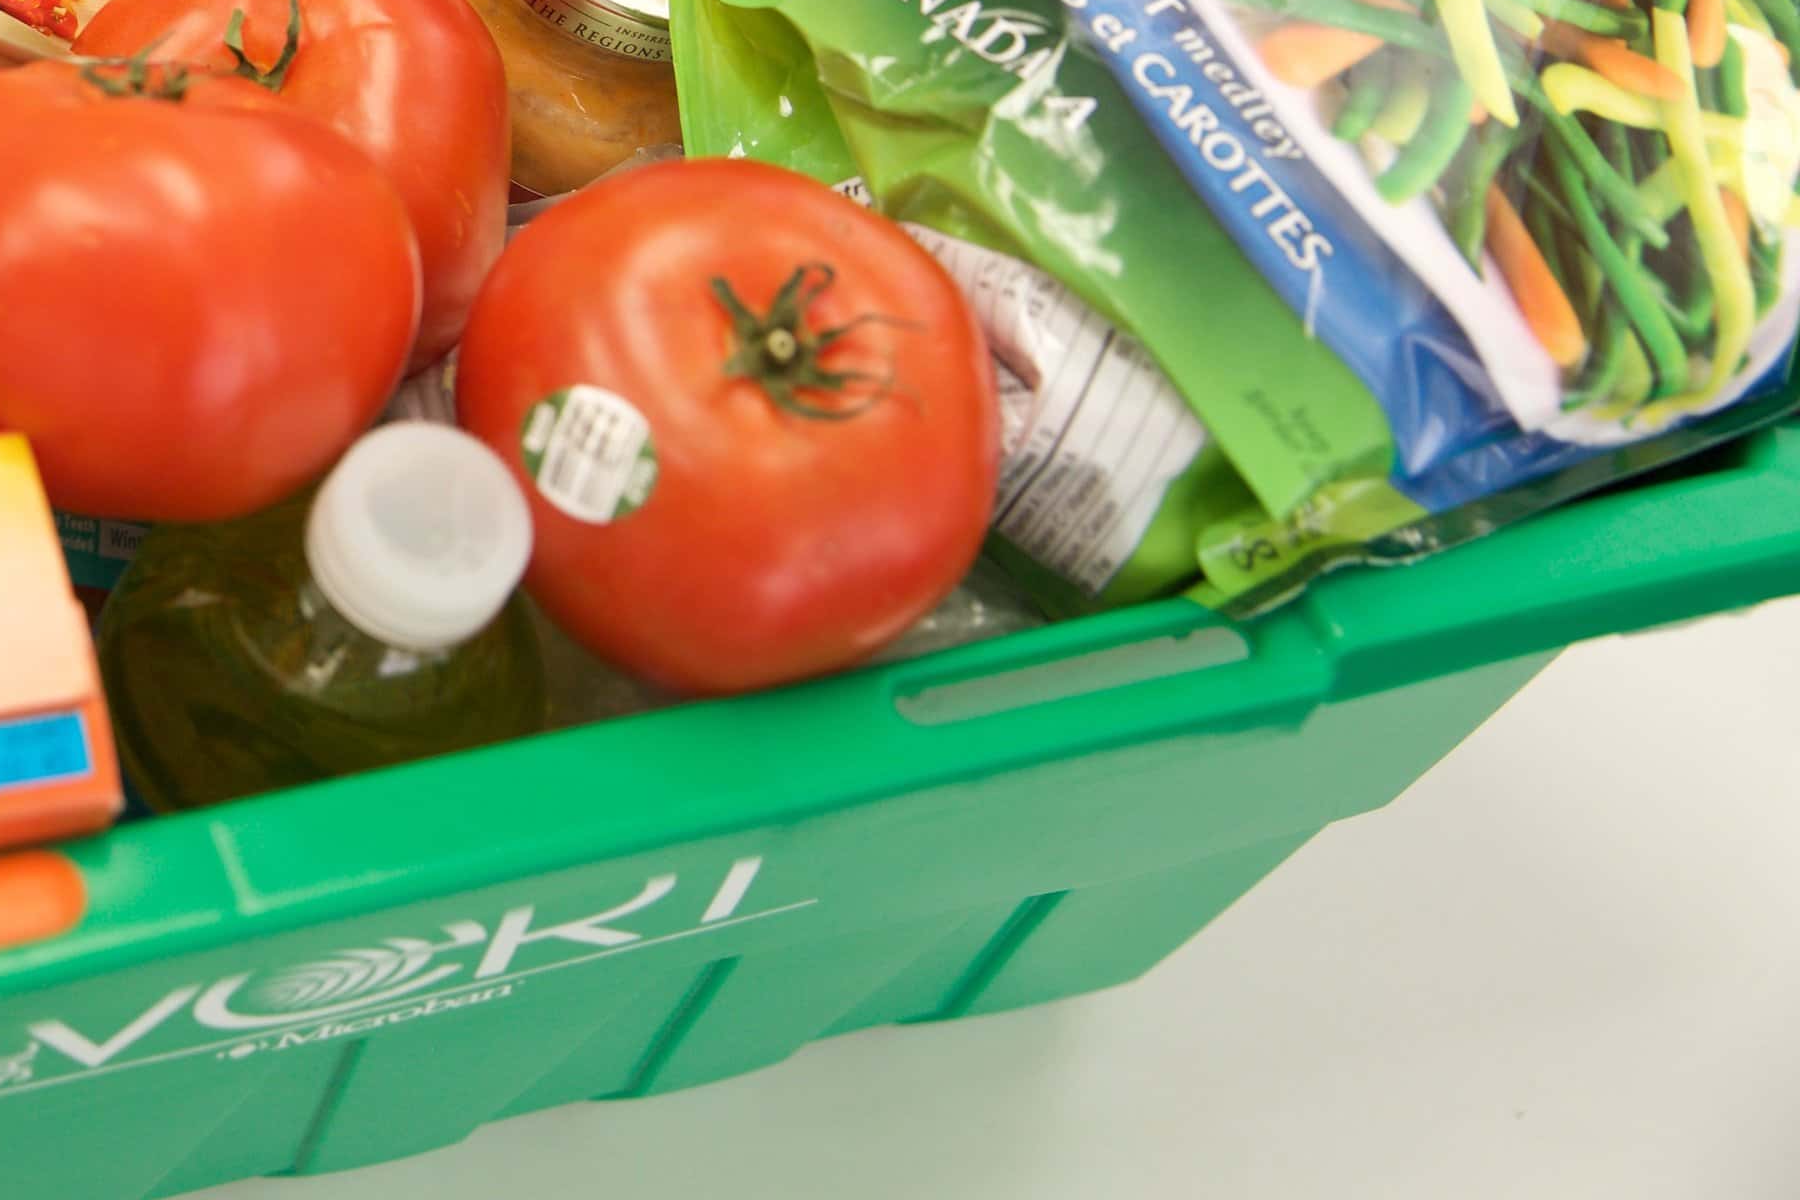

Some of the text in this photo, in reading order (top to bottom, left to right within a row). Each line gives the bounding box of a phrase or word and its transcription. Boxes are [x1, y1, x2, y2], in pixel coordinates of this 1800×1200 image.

[573, 23, 665, 61] REGIONS
[1173, 25, 1304, 163] medley
[1090, 11, 1138, 55] et
[1131, 52, 1336, 273] CAROTTES
